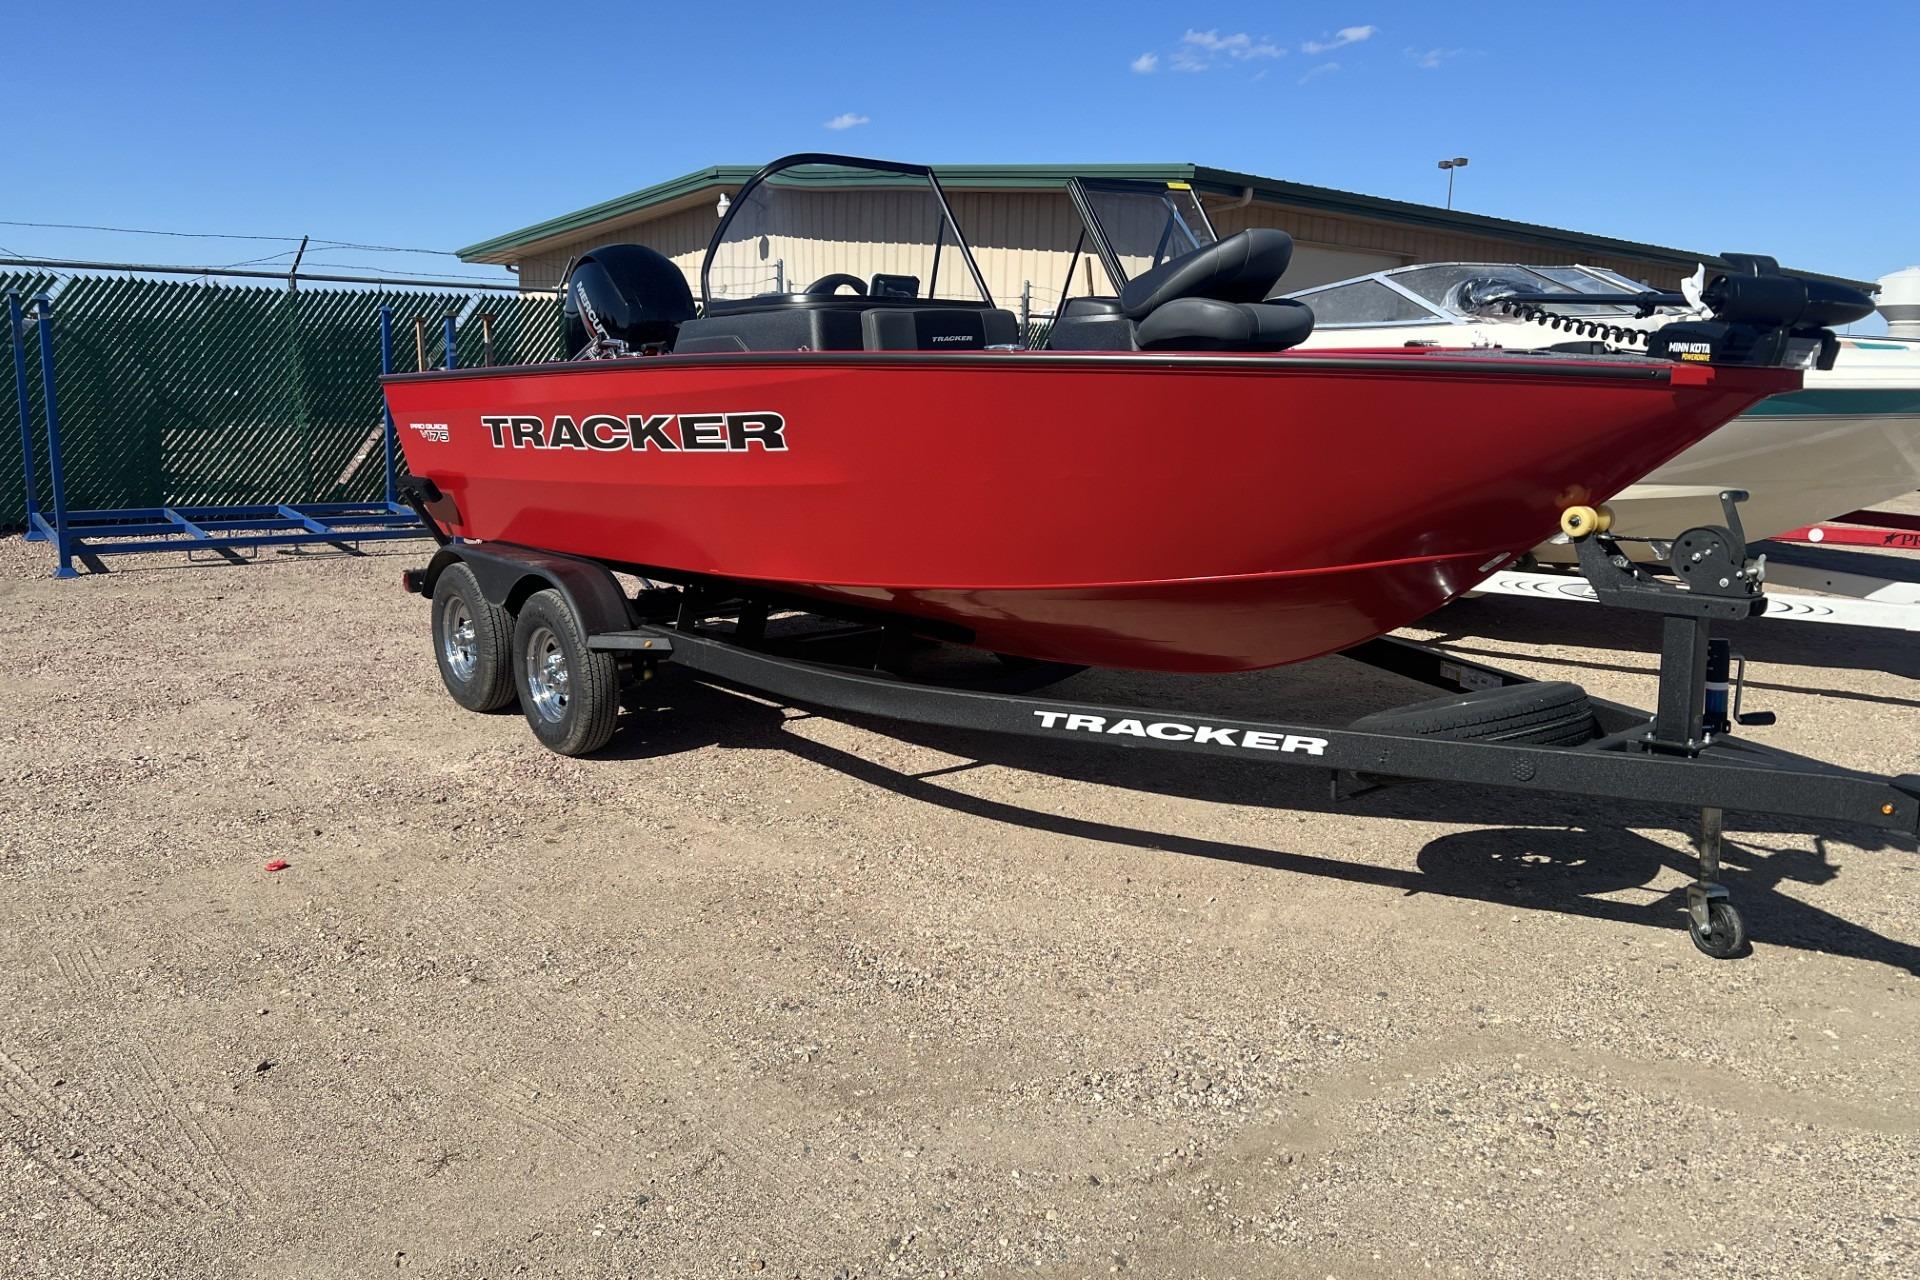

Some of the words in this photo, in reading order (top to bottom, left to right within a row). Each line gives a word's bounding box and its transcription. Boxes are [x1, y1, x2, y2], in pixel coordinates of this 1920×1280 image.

[577, 281, 610, 339] MERCUR
[1668, 342, 1689, 352] MINN
[1690, 343, 1711, 353] KOTA
[481, 411, 789, 452] TRACKER
[1033, 710, 1329, 756] TRACKER
